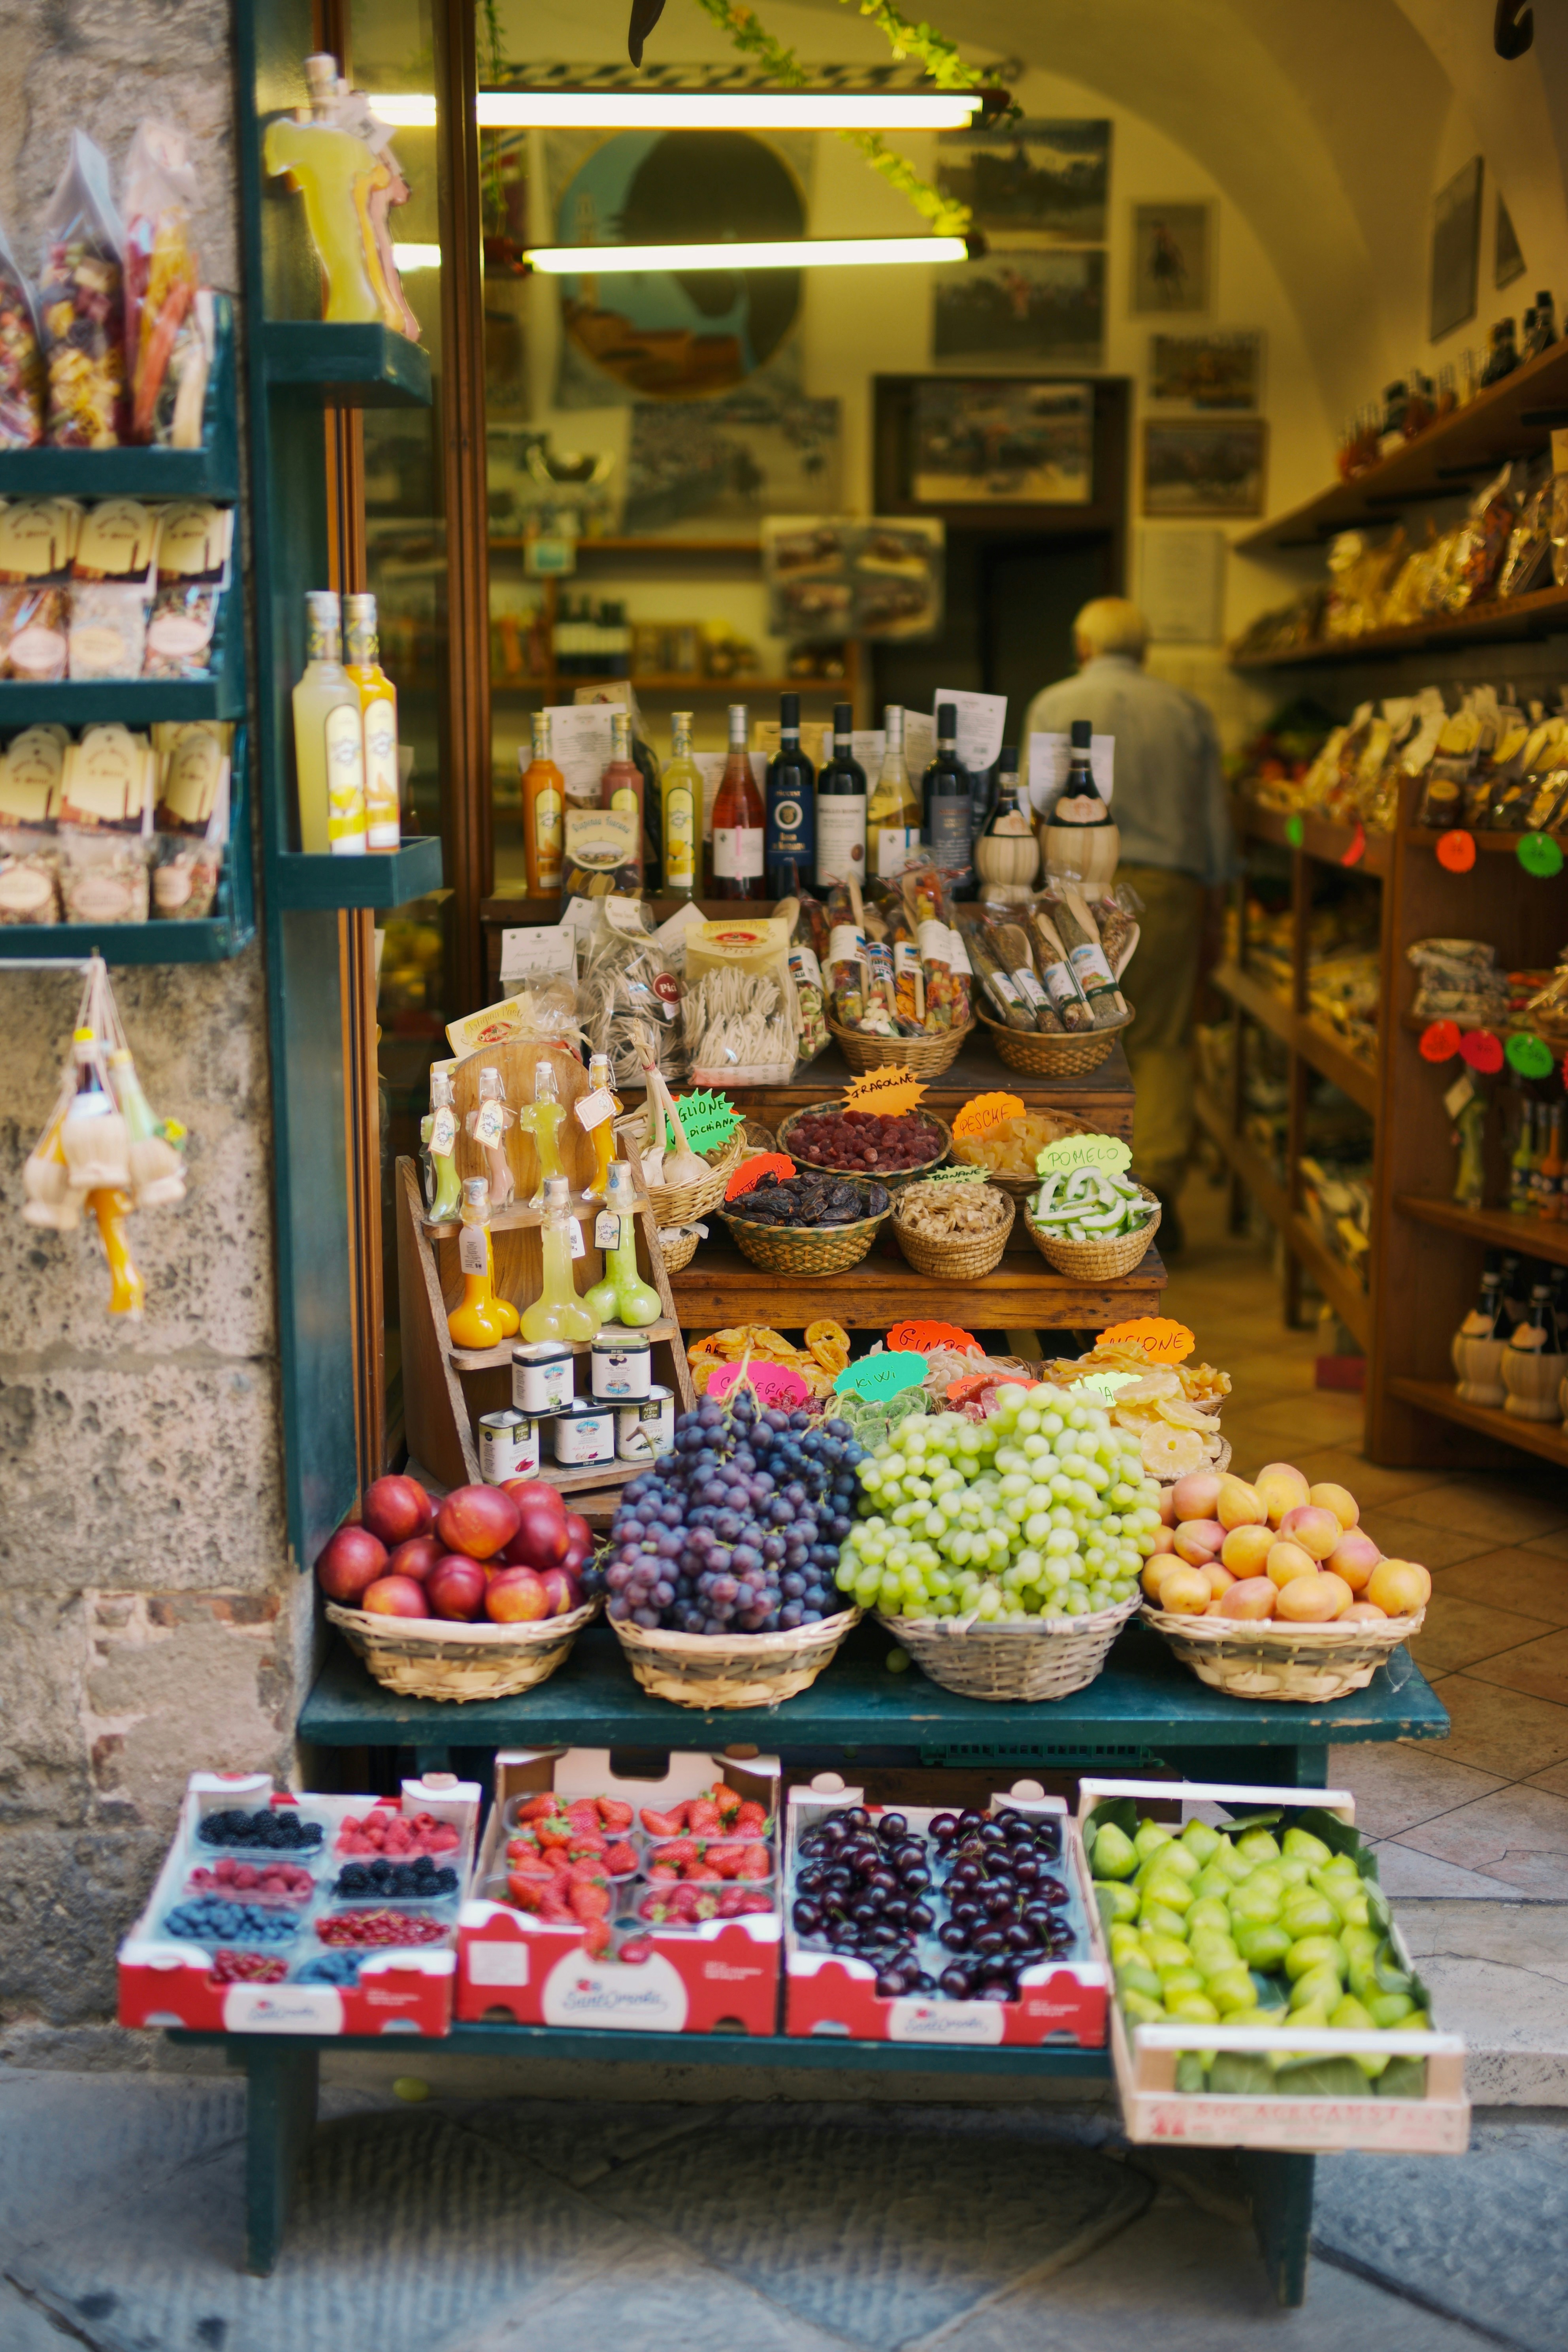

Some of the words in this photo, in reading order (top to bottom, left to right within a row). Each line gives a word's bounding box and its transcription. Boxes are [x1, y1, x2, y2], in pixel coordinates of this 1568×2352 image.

[659, 983, 677, 993] Pici
[1048, 1148, 1118, 1167] POMELO
[932, 1168, 984, 1181] BANANE
[509, 1449, 536, 1461] Peperoncino
